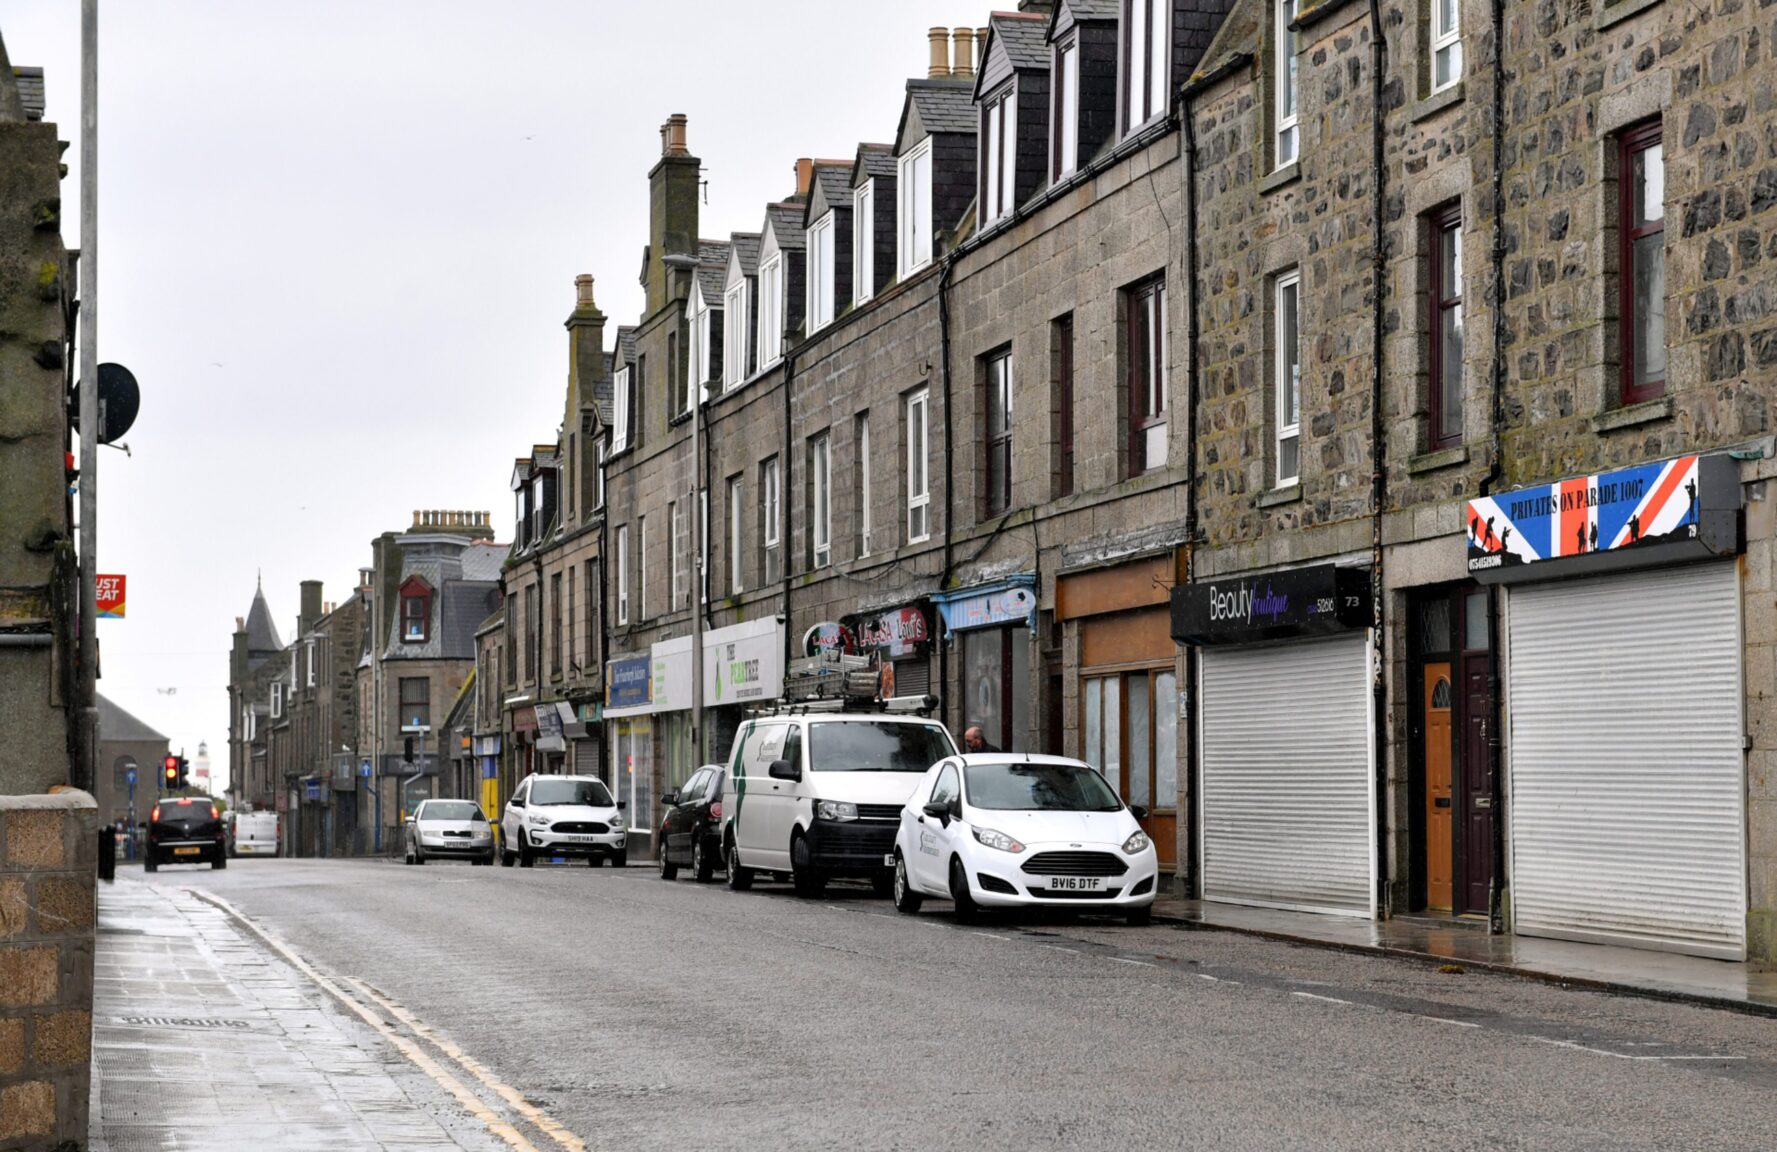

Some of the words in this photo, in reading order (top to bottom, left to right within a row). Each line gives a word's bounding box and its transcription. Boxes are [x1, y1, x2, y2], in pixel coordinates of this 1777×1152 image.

[1511, 494, 1557, 521] PRIVATES
[1560, 491, 1574, 512] ON
[1577, 483, 1618, 509] PARADE
[1620, 478, 1644, 501] 1007
[1688, 524, 1697, 538] 79
[96, 578, 120, 589] UST
[96, 590, 120, 601] EAT
[1345, 596, 1360, 607] 73
[1210, 582, 1253, 625] Beauty
[1052, 877, 1076, 889] BV16
[1079, 878, 1100, 889] DTF
